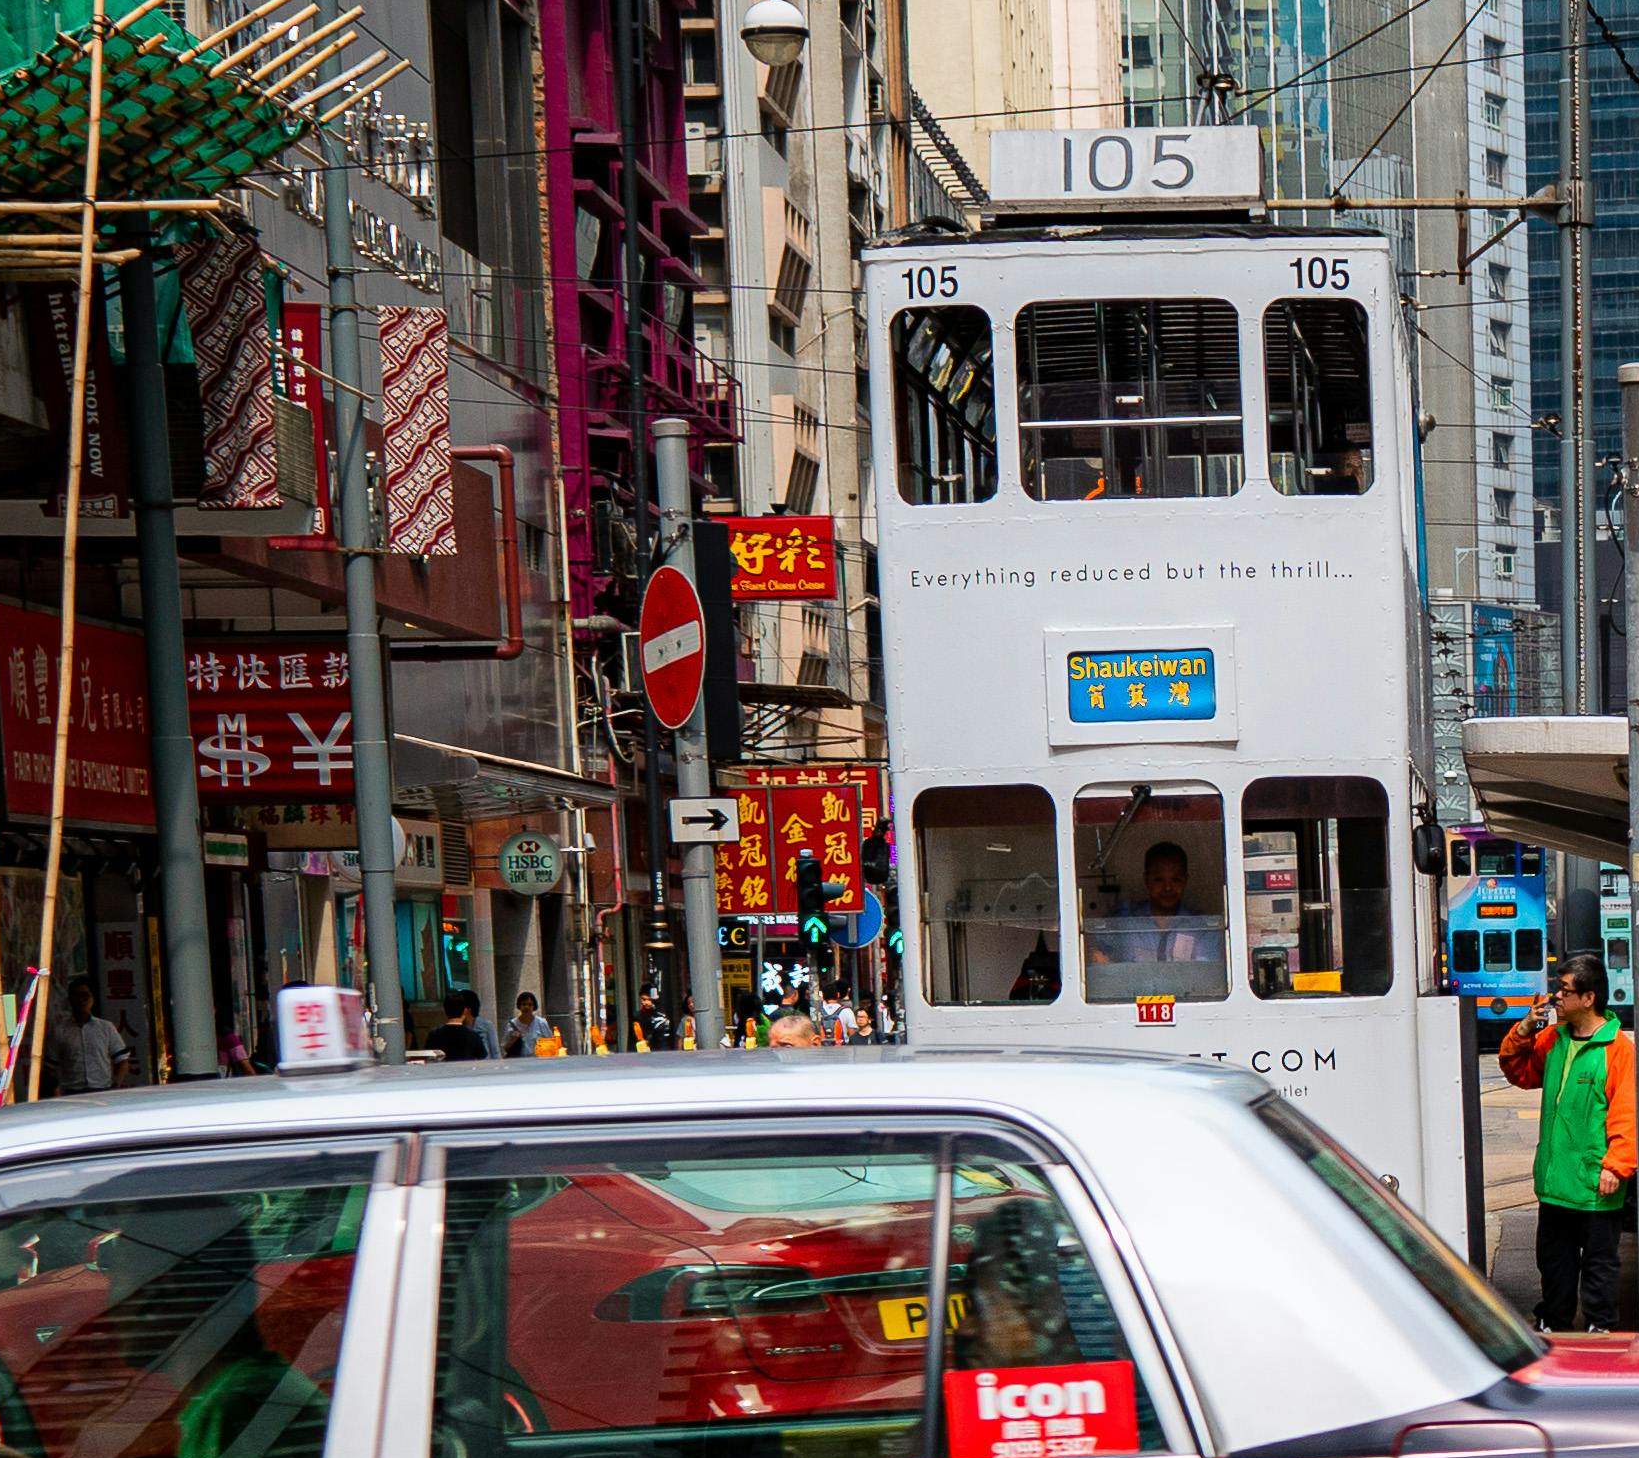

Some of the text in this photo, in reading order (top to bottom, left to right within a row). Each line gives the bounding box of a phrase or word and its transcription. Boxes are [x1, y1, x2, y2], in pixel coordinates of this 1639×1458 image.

[1063, 134, 1194, 192] 105
[902, 265, 959, 299] 105
[1290, 256, 1350, 291] 105
[89, 433, 104, 478] NOW
[911, 567, 1037, 590] Everything
[1050, 563, 1152, 583] reduced
[1166, 561, 1206, 580] but
[1220, 561, 1257, 580] the
[188, 652, 351, 692] 特快匯款
[1069, 654, 1207, 680] Shaukeiwan
[506, 854, 553, 870] HSBC
[1139, 1005, 1172, 1022] 118
[974, 1371, 1107, 1421] icon
